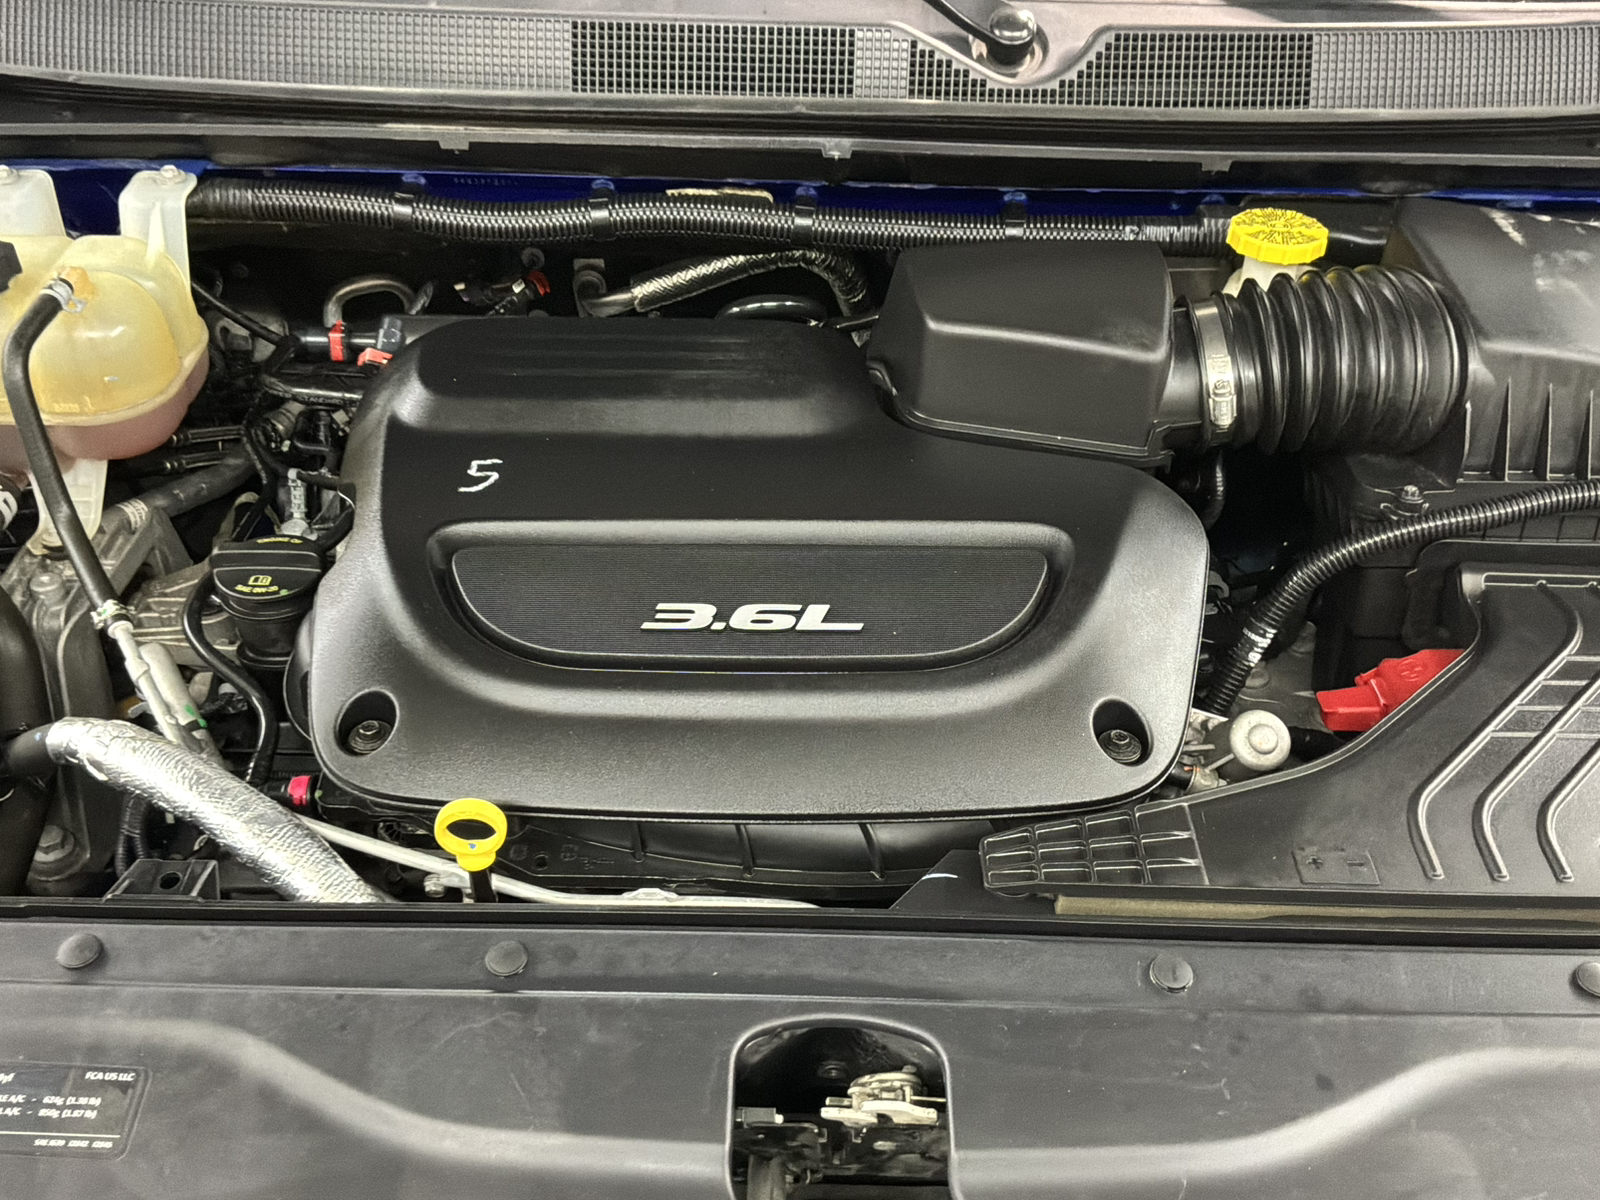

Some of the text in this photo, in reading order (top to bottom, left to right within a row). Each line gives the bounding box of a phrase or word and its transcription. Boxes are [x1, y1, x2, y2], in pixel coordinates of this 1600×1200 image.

[457, 458, 503, 492] 5
[640, 602, 864, 632] 3.6L
[85, 1071, 136, 1081] FCA US LLC
[8, 1094, 27, 1104] A/C
